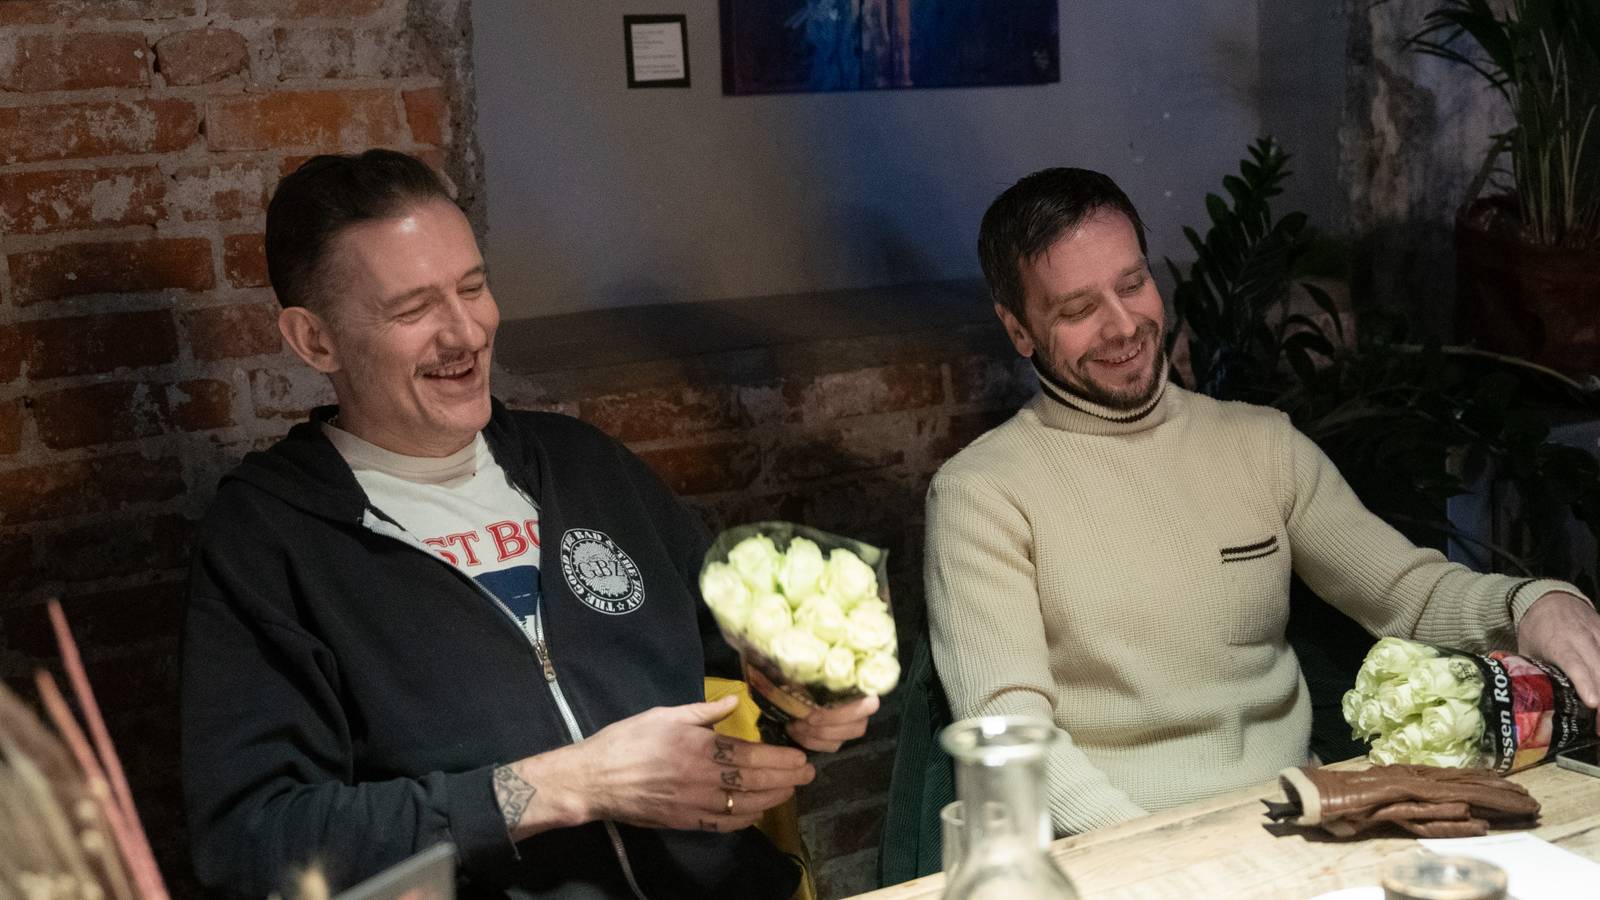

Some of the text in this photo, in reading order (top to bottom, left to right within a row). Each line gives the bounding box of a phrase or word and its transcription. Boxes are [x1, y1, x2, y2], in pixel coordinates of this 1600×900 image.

[573, 531, 602, 541] BAD
[562, 554, 585, 594] GOOD
[617, 550, 637, 577] THE
[585, 593, 616, 612] THE
